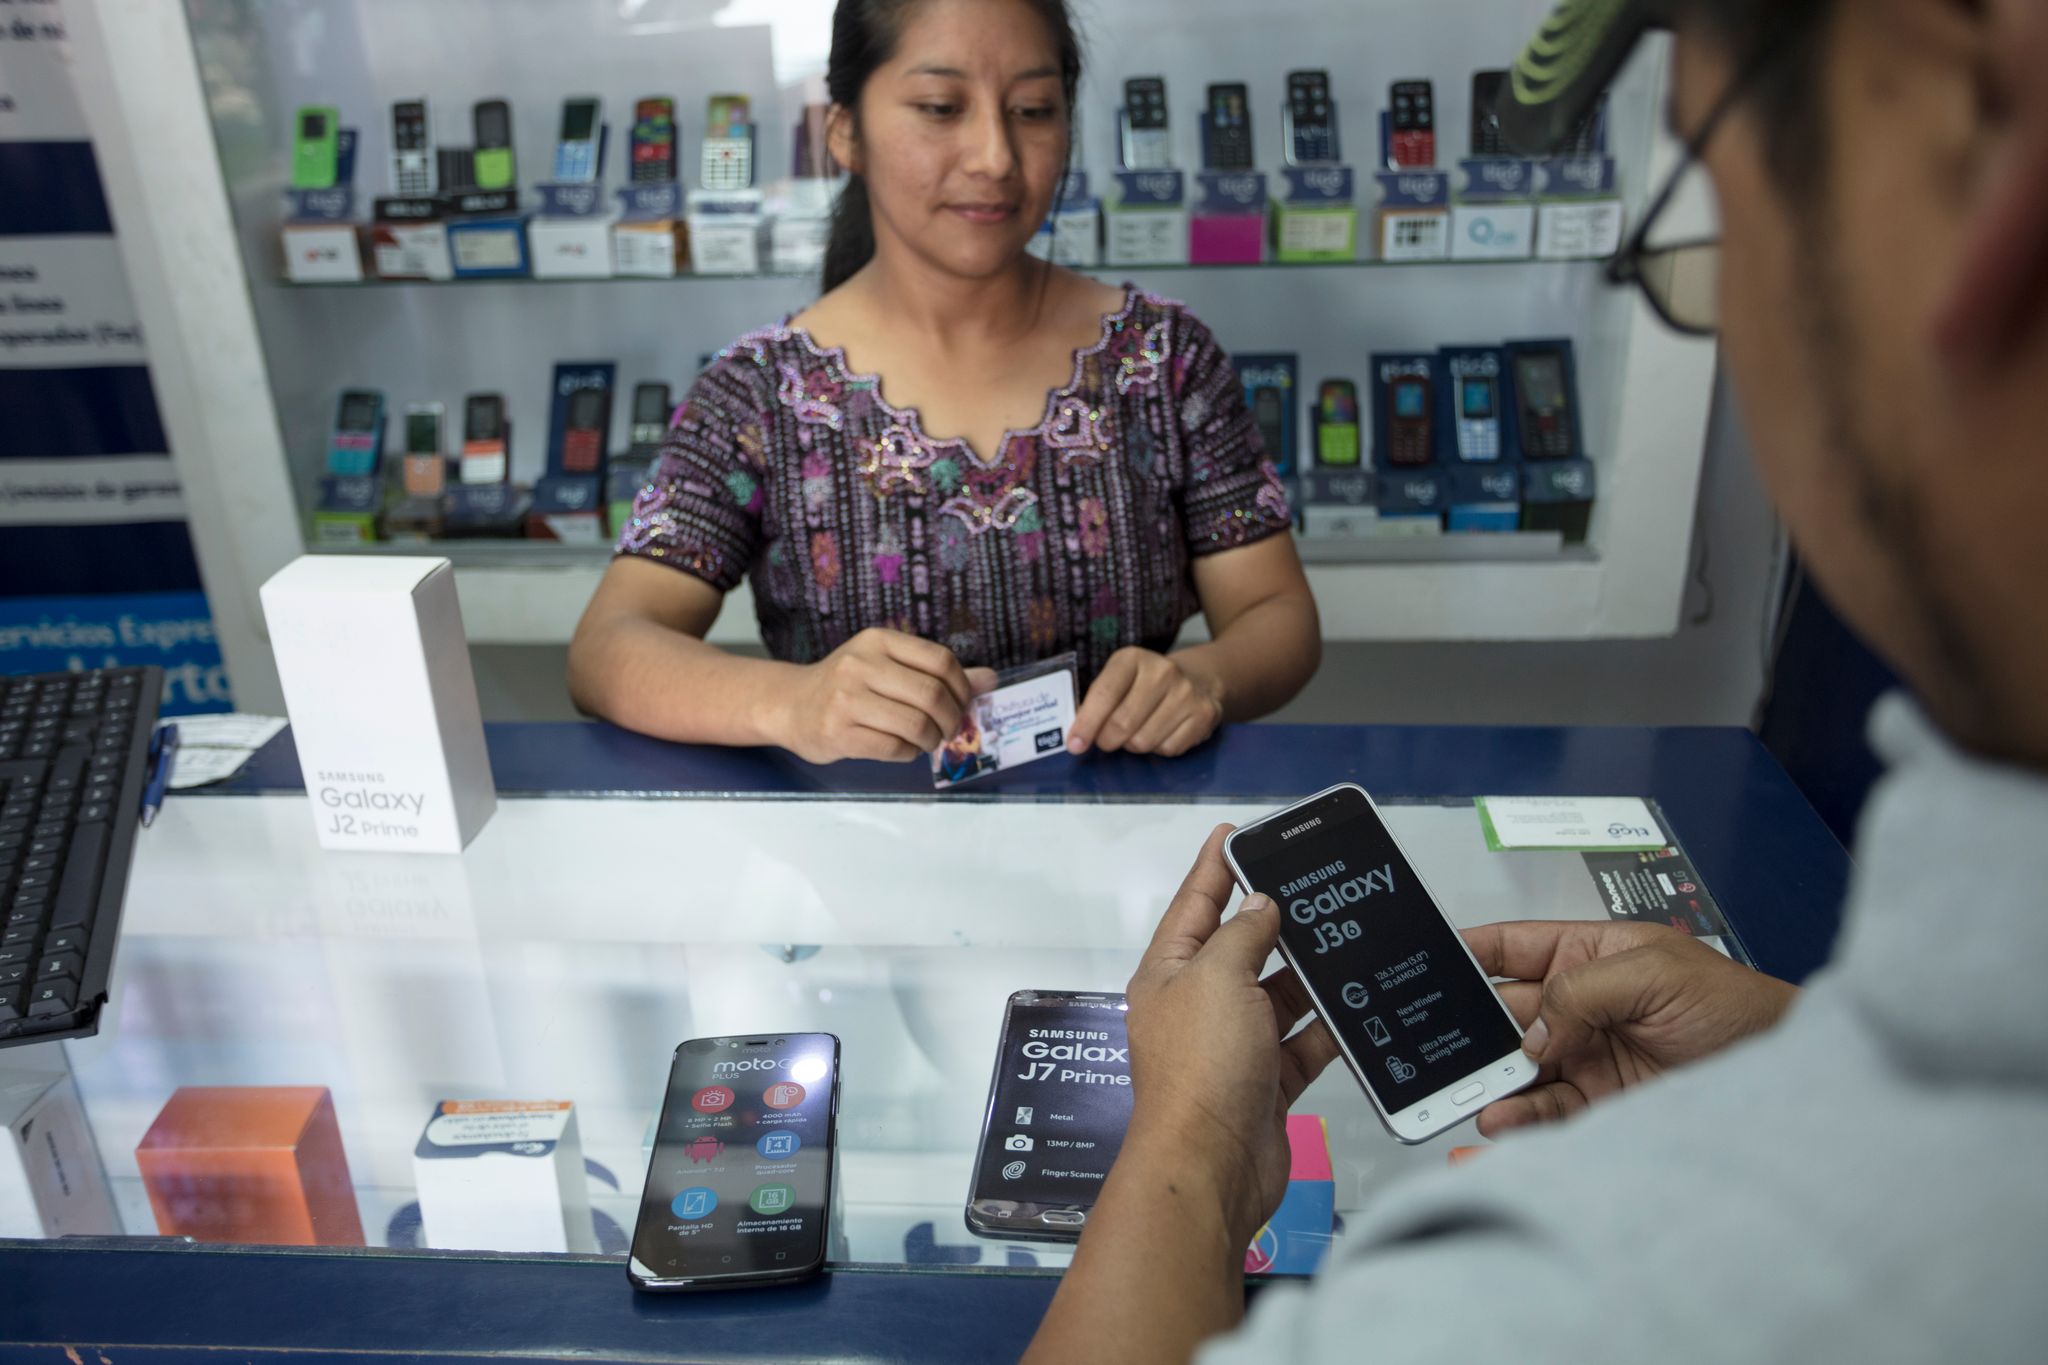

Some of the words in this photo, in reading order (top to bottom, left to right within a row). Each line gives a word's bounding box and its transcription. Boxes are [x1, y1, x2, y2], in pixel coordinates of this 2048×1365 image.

[0, 614, 115, 648] ervicios
[319, 771, 385, 783] SAMSUNG
[320, 787, 424, 816] Galaxy
[329, 813, 357, 836] J2
[361, 820, 419, 838] Prime
[1281, 817, 1322, 840] SAMSUNG
[1280, 860, 1346, 897] SAMSUNG
[1289, 864, 1395, 924] Galaxy
[1600, 871, 1629, 915] Pioneer
[1374, 966, 1395, 981] 126.3
[1394, 961, 1409, 972] mm
[1380, 980, 1394, 991] HD
[1396, 1004, 1415, 1017] New
[1412, 990, 1443, 1009] Window
[1401, 1009, 1429, 1027] Design
[1029, 1029, 1109, 1041] SAMSUNG
[1418, 1041, 1439, 1054] Ultra
[1436, 1028, 1461, 1045] Power
[742, 1046, 771, 1054] moto
[1022, 1041, 1129, 1063] Galax
[1424, 1047, 1452, 1064] Saving
[1449, 1035, 1471, 1052] Mode
[712, 1072, 740, 1080] PLUS
[1017, 1062, 1057, 1081] J7
[1060, 1070, 1132, 1085] Prime
[1050, 1113, 1074, 1121] Metal
[1041, 1168, 1069, 1178] Finger
[1070, 1170, 1105, 1179] Scanner
[668, 1223, 699, 1231] Pantalla
[737, 1217, 803, 1227] Almacenamiento
